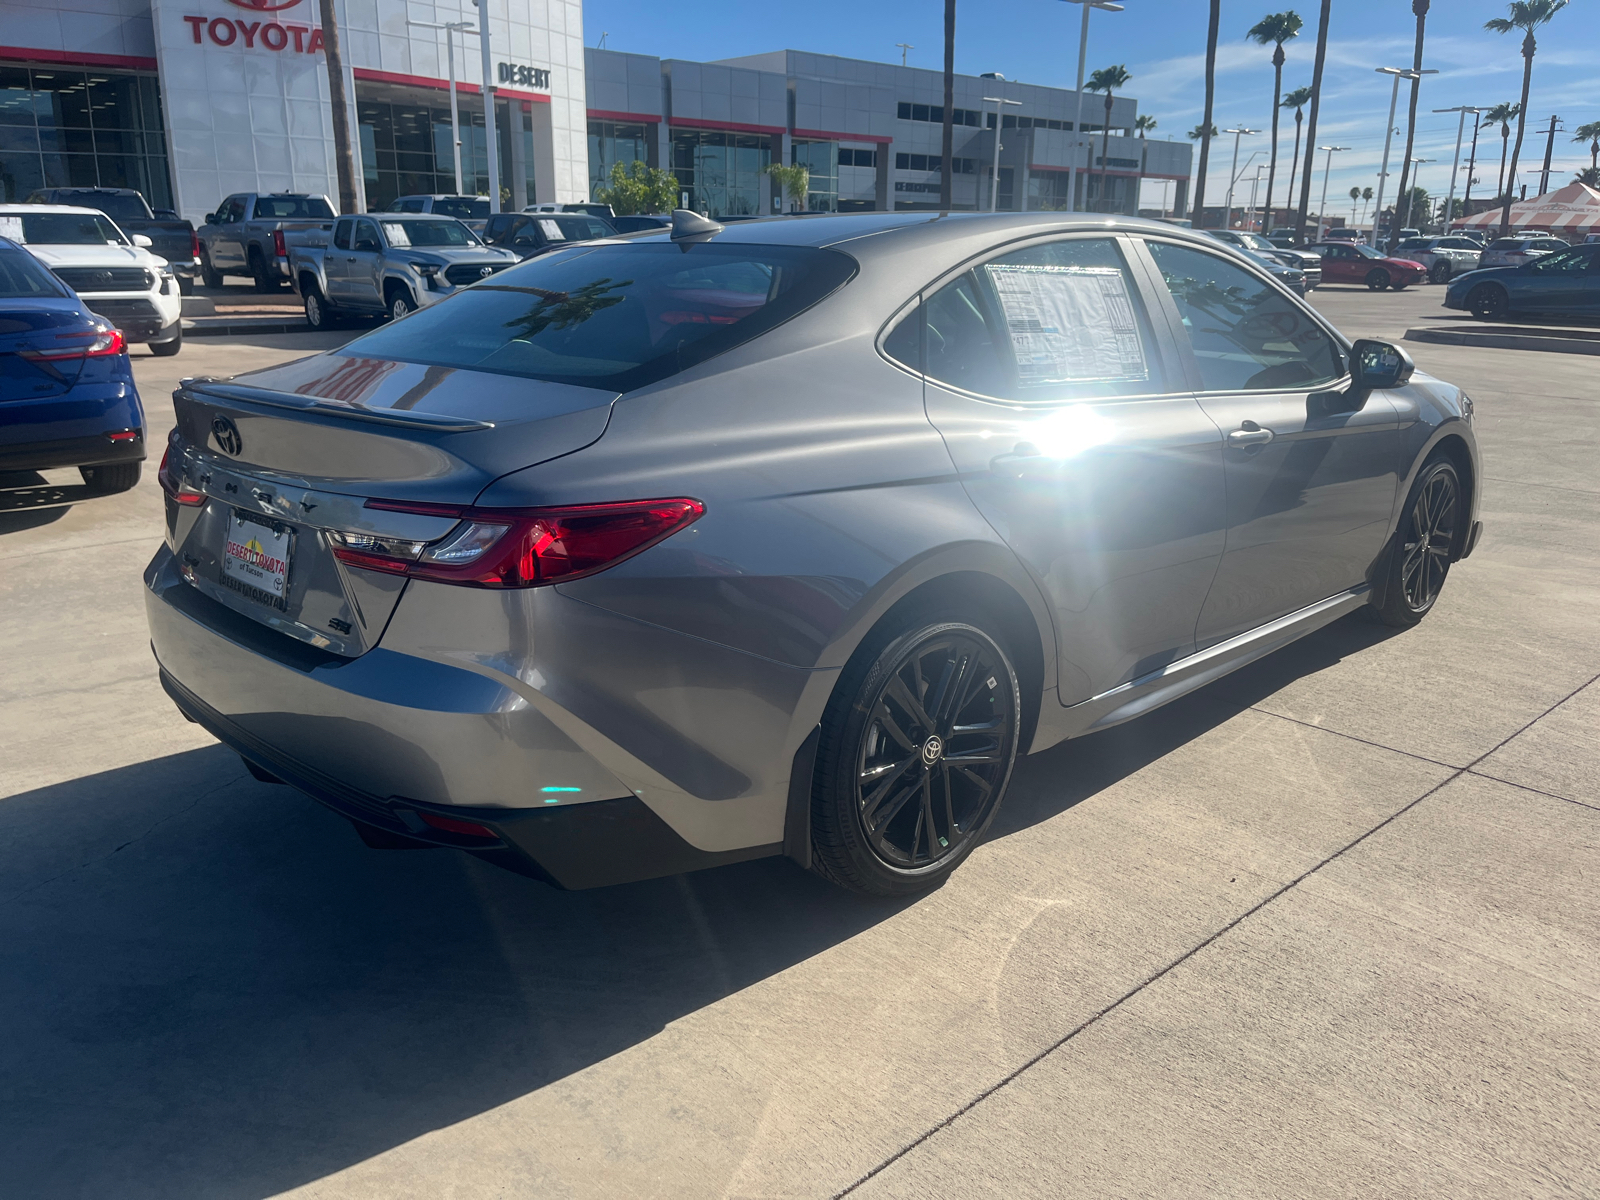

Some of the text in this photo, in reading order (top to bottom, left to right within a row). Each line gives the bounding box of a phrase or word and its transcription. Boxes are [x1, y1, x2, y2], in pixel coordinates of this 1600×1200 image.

[184, 15, 325, 54] TOYOTA
[498, 61, 551, 90] DESERT
[226, 541, 285, 575] DESERT TOYOTA
[246, 564, 264, 578] Tucson
